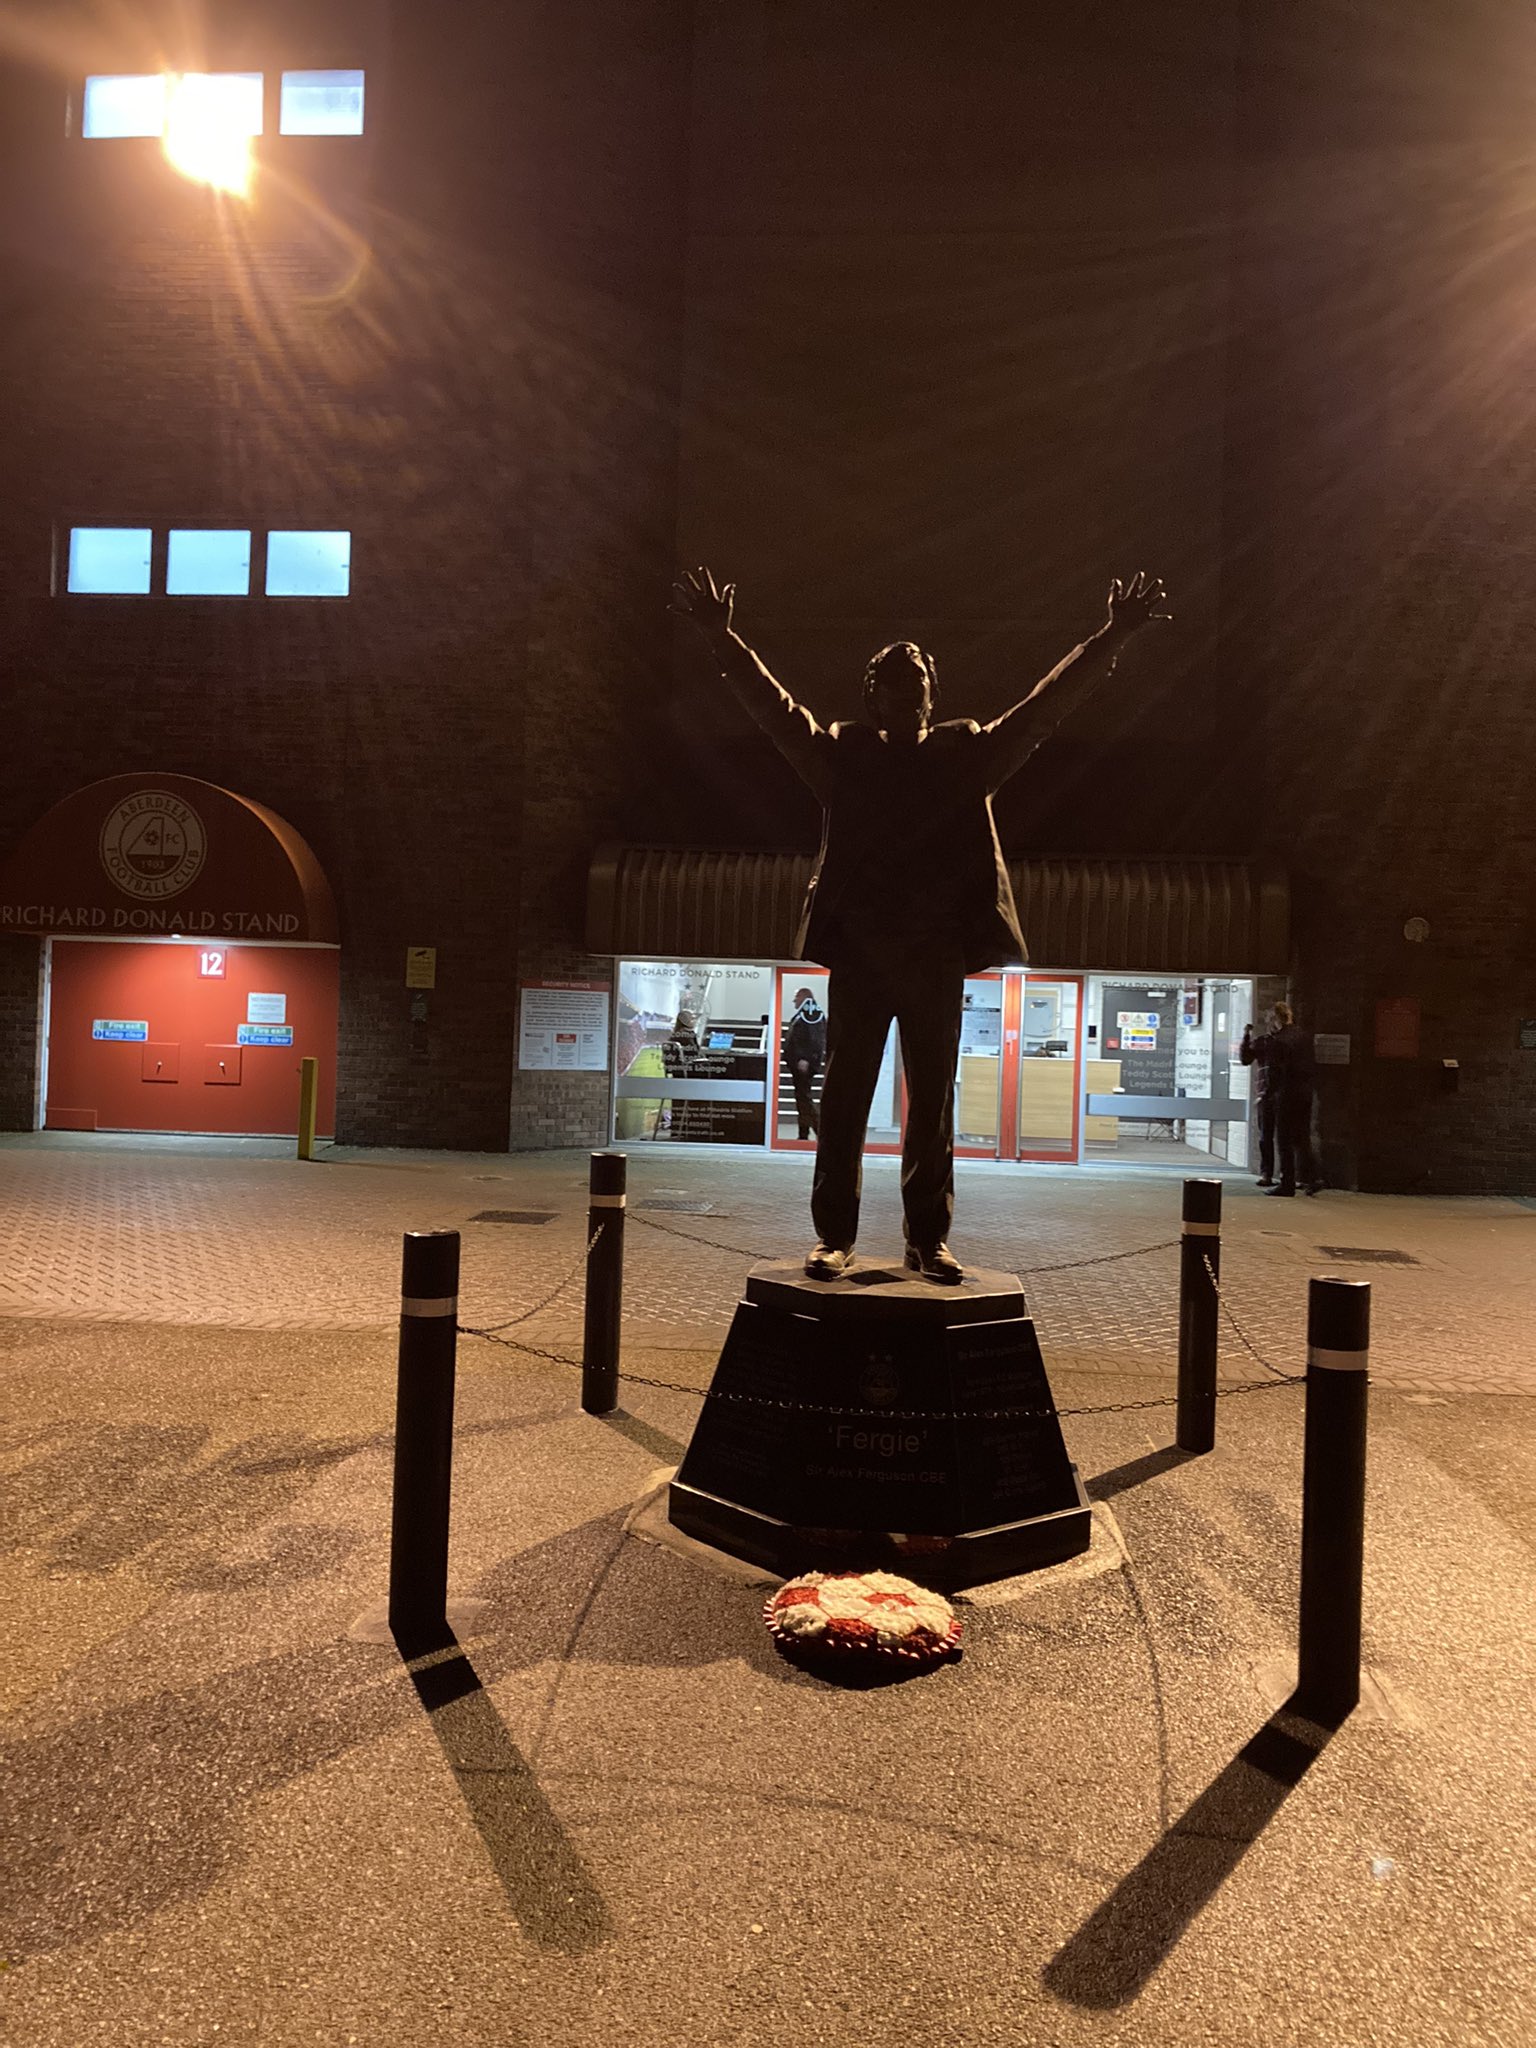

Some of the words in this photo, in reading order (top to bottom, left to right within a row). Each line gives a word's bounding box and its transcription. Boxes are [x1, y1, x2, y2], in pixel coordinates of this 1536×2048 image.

[119, 797, 191, 823] ABERDEEN
[165, 833, 181, 845] FC
[106, 847, 170, 894] FOOTBALL
[172, 849, 200, 885] CLUB
[1, 906, 106, 927] RICHARD
[113, 908, 216, 931] DONALD
[222, 911, 300, 934] STAND
[201, 952, 223, 976] 12
[631, 967, 677, 977] RICHARD
[679, 969, 723, 979] DONALD
[725, 970, 761, 980] STAND
[1202, 983, 1239, 994] SND
[109, 1022, 125, 1030] Fire
[126, 1022, 140, 1030] exit
[253, 1027, 270, 1035] Fire
[271, 1027, 286, 1035] exit
[105, 1031, 123, 1039] Keep
[125, 1031, 144, 1039] clear
[249, 1036, 269, 1044] Keep
[1178, 1048, 1198, 1057] you
[1198, 1047, 1210, 1056] to
[1128, 1059, 1145, 1068] The
[695, 1064, 727, 1074] Lounge
[1122, 1070, 1150, 1079] Teddy
[1129, 1080, 1168, 1089] Legends
[806, 1464, 823, 1476] Sir
[827, 1465, 854, 1479] Alex
[857, 1467, 916, 1483] Ferguson
